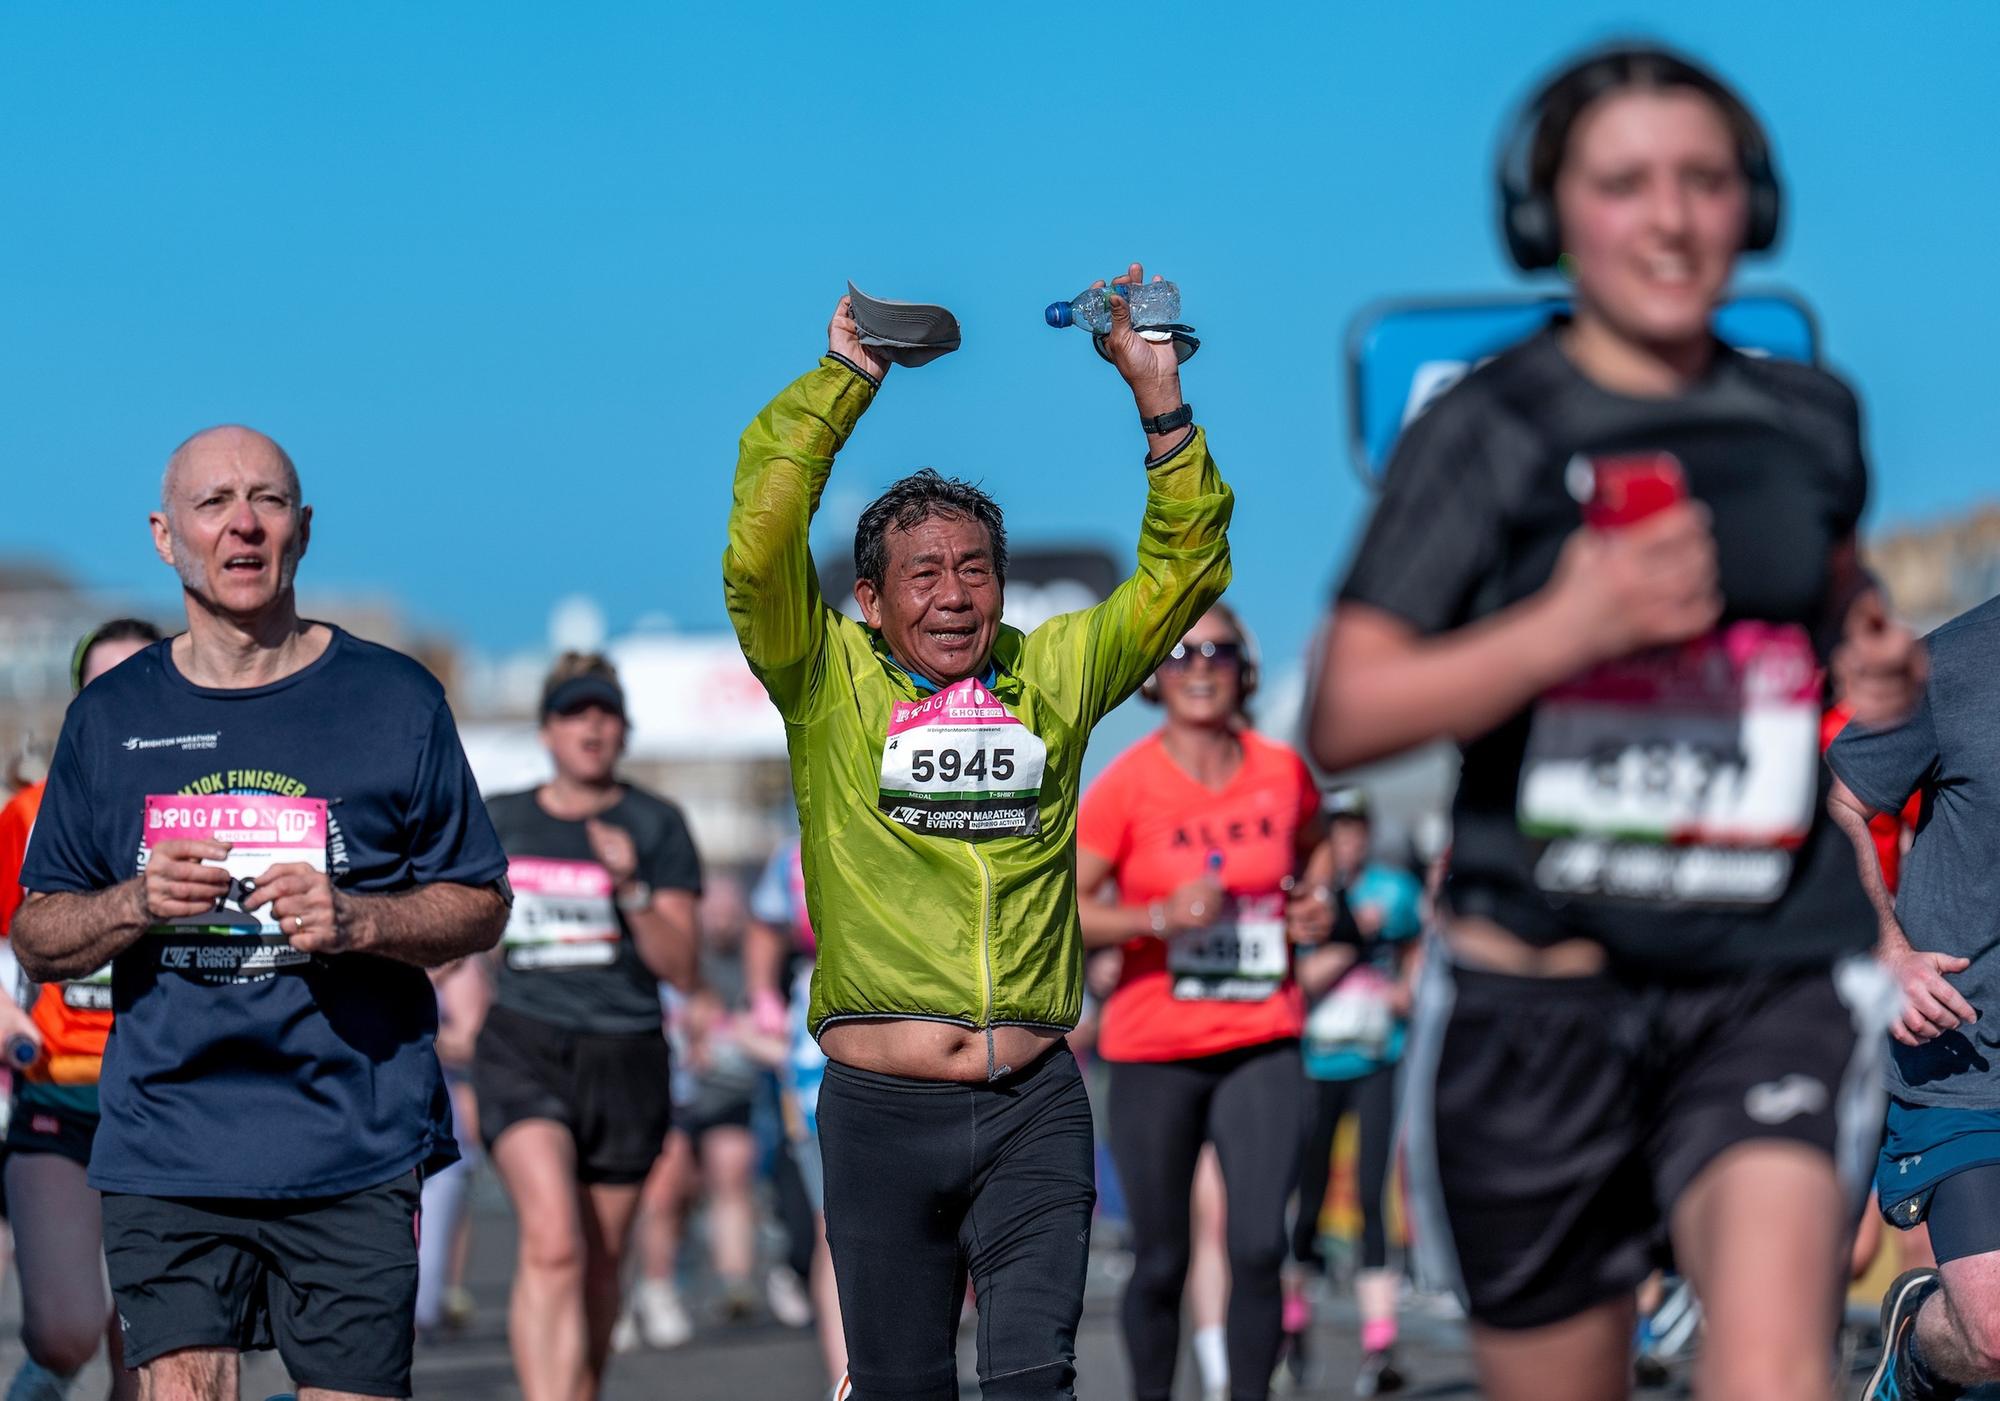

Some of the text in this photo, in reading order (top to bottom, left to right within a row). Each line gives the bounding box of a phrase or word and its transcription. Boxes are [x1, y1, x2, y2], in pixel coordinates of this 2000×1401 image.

[960, 709, 985, 717] HOVE
[139, 734, 217, 749] BRIGHTON MARATHON
[181, 742, 217, 751] WEEKEND
[889, 740, 898, 750] 4
[911, 748, 1015, 783] 5945
[227, 769, 307, 798] FINISHER
[908, 791, 932, 800] MEDAL
[149, 807, 276, 829] BRIGHTON
[927, 810, 971, 821] LONDON
[973, 808, 1026, 821] MARATHON
[926, 820, 964, 829] EVENTS
[196, 946, 243, 958] LONDON
[196, 957, 237, 969] EVENTS
